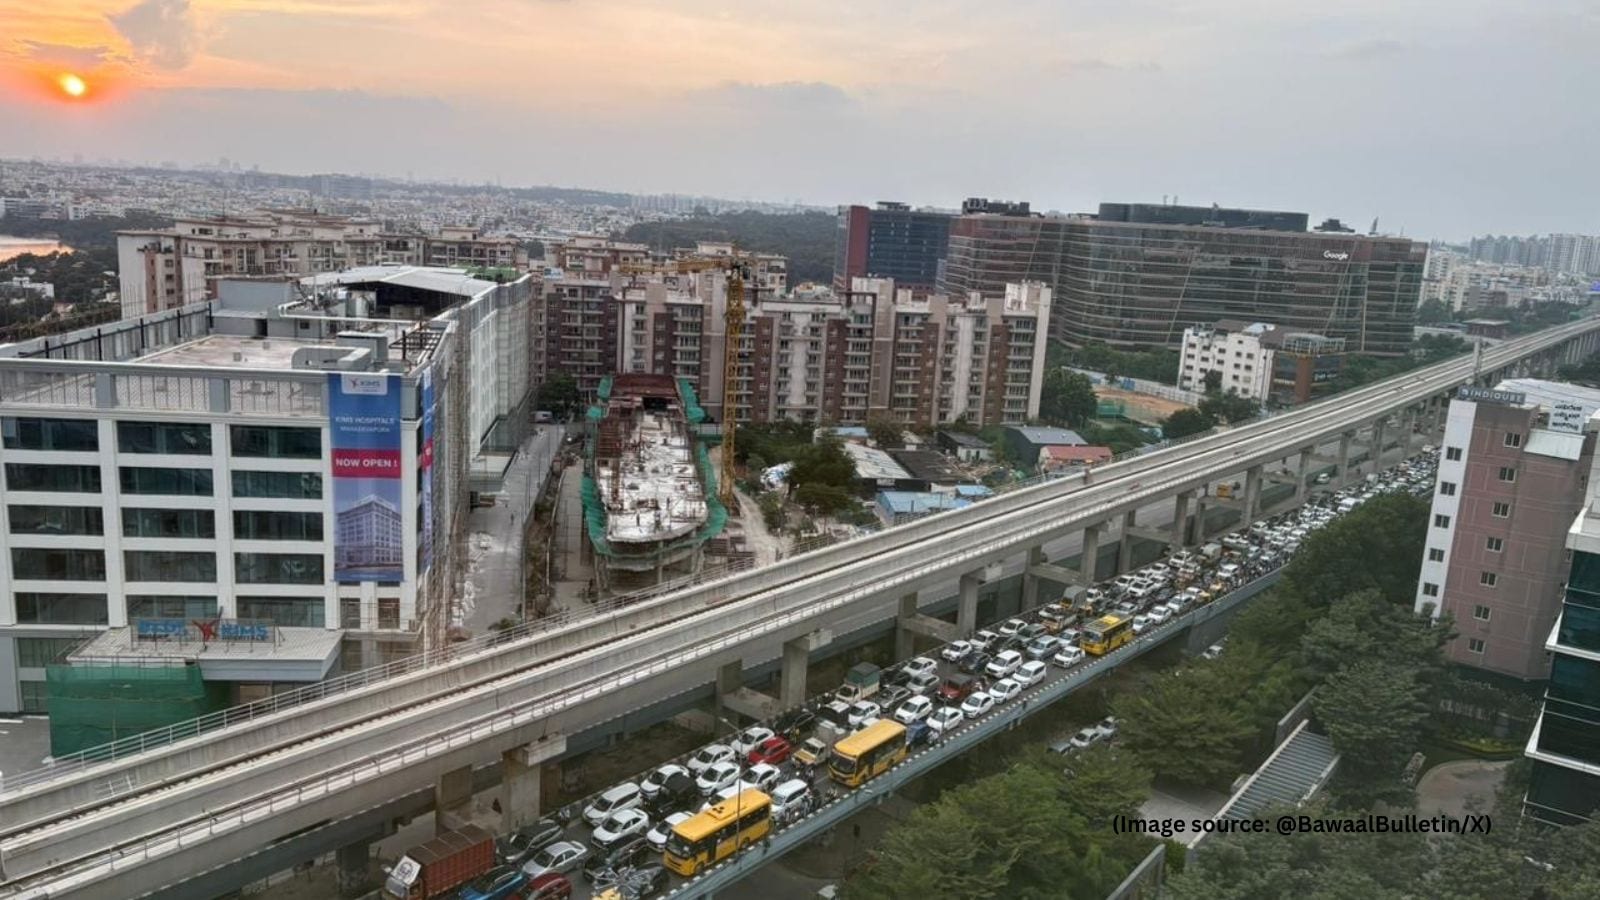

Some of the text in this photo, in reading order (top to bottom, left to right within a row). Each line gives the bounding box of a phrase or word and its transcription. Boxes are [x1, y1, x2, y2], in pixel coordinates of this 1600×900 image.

[1323, 250, 1349, 260] Google
[355, 416, 395, 424] HOSPITALS
[335, 458, 360, 468] NOW
[362, 458, 392, 468] OPEN
